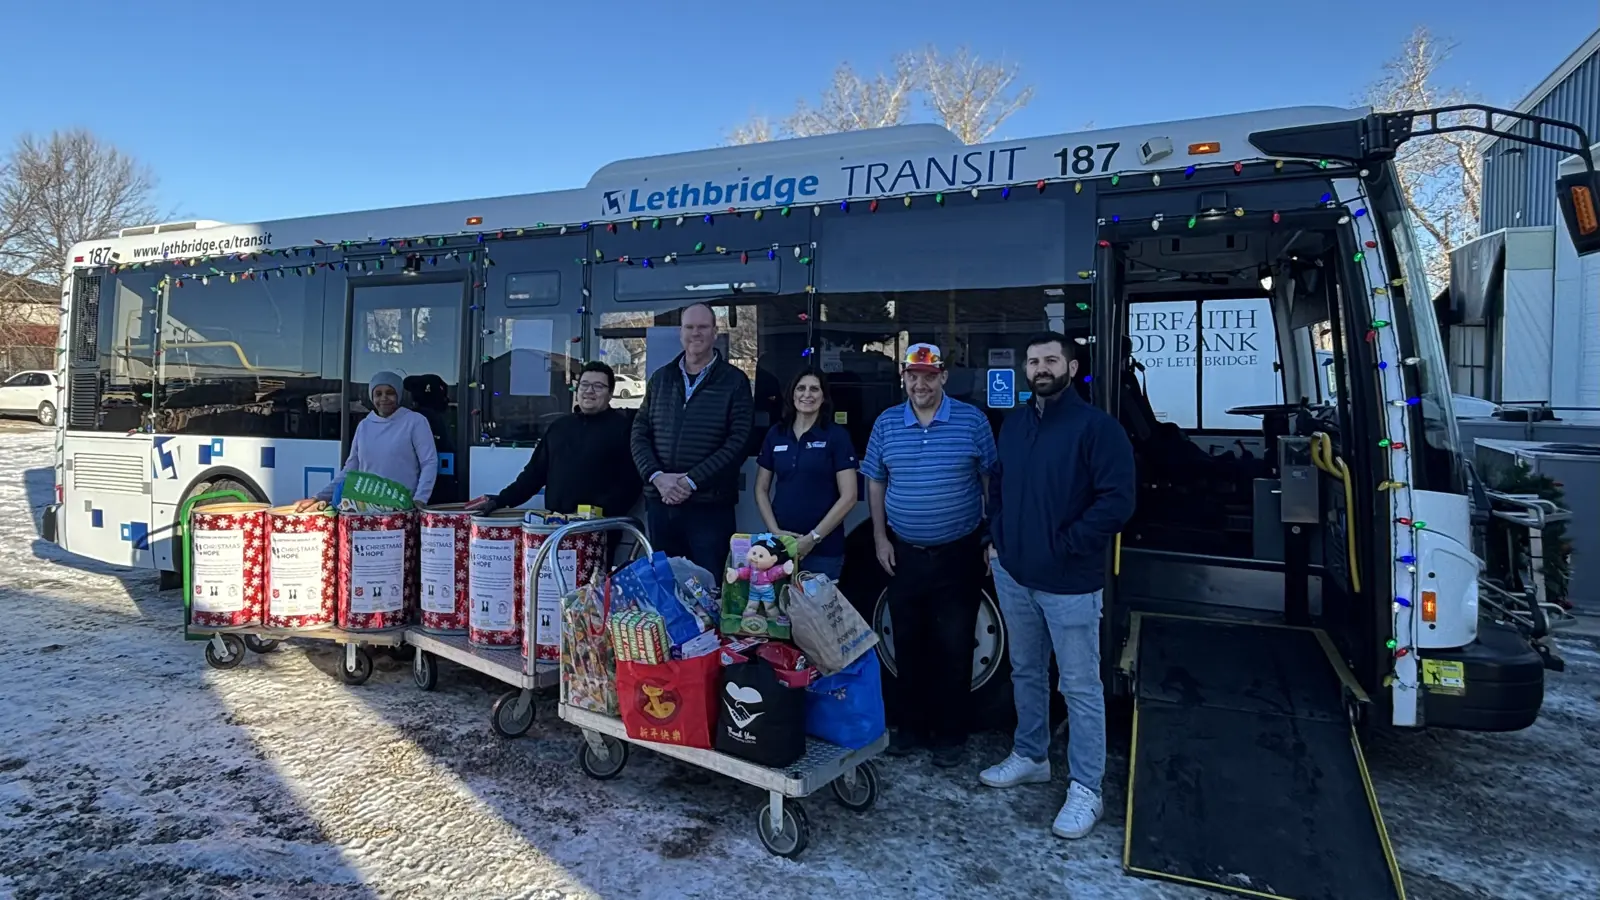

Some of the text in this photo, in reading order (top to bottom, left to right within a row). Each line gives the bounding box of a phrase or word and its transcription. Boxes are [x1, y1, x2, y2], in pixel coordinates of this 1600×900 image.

[1053, 142, 1122, 176] 187
[628, 146, 1027, 213] Lethbridge TRANSIT
[89, 247, 112, 264] 187
[133, 232, 272, 258] www.lethbridge.ca/transit
[1174, 332, 1260, 353] BANK
[1145, 358, 1164, 368] OF
[476, 553, 512, 561] CHRISTMAS
